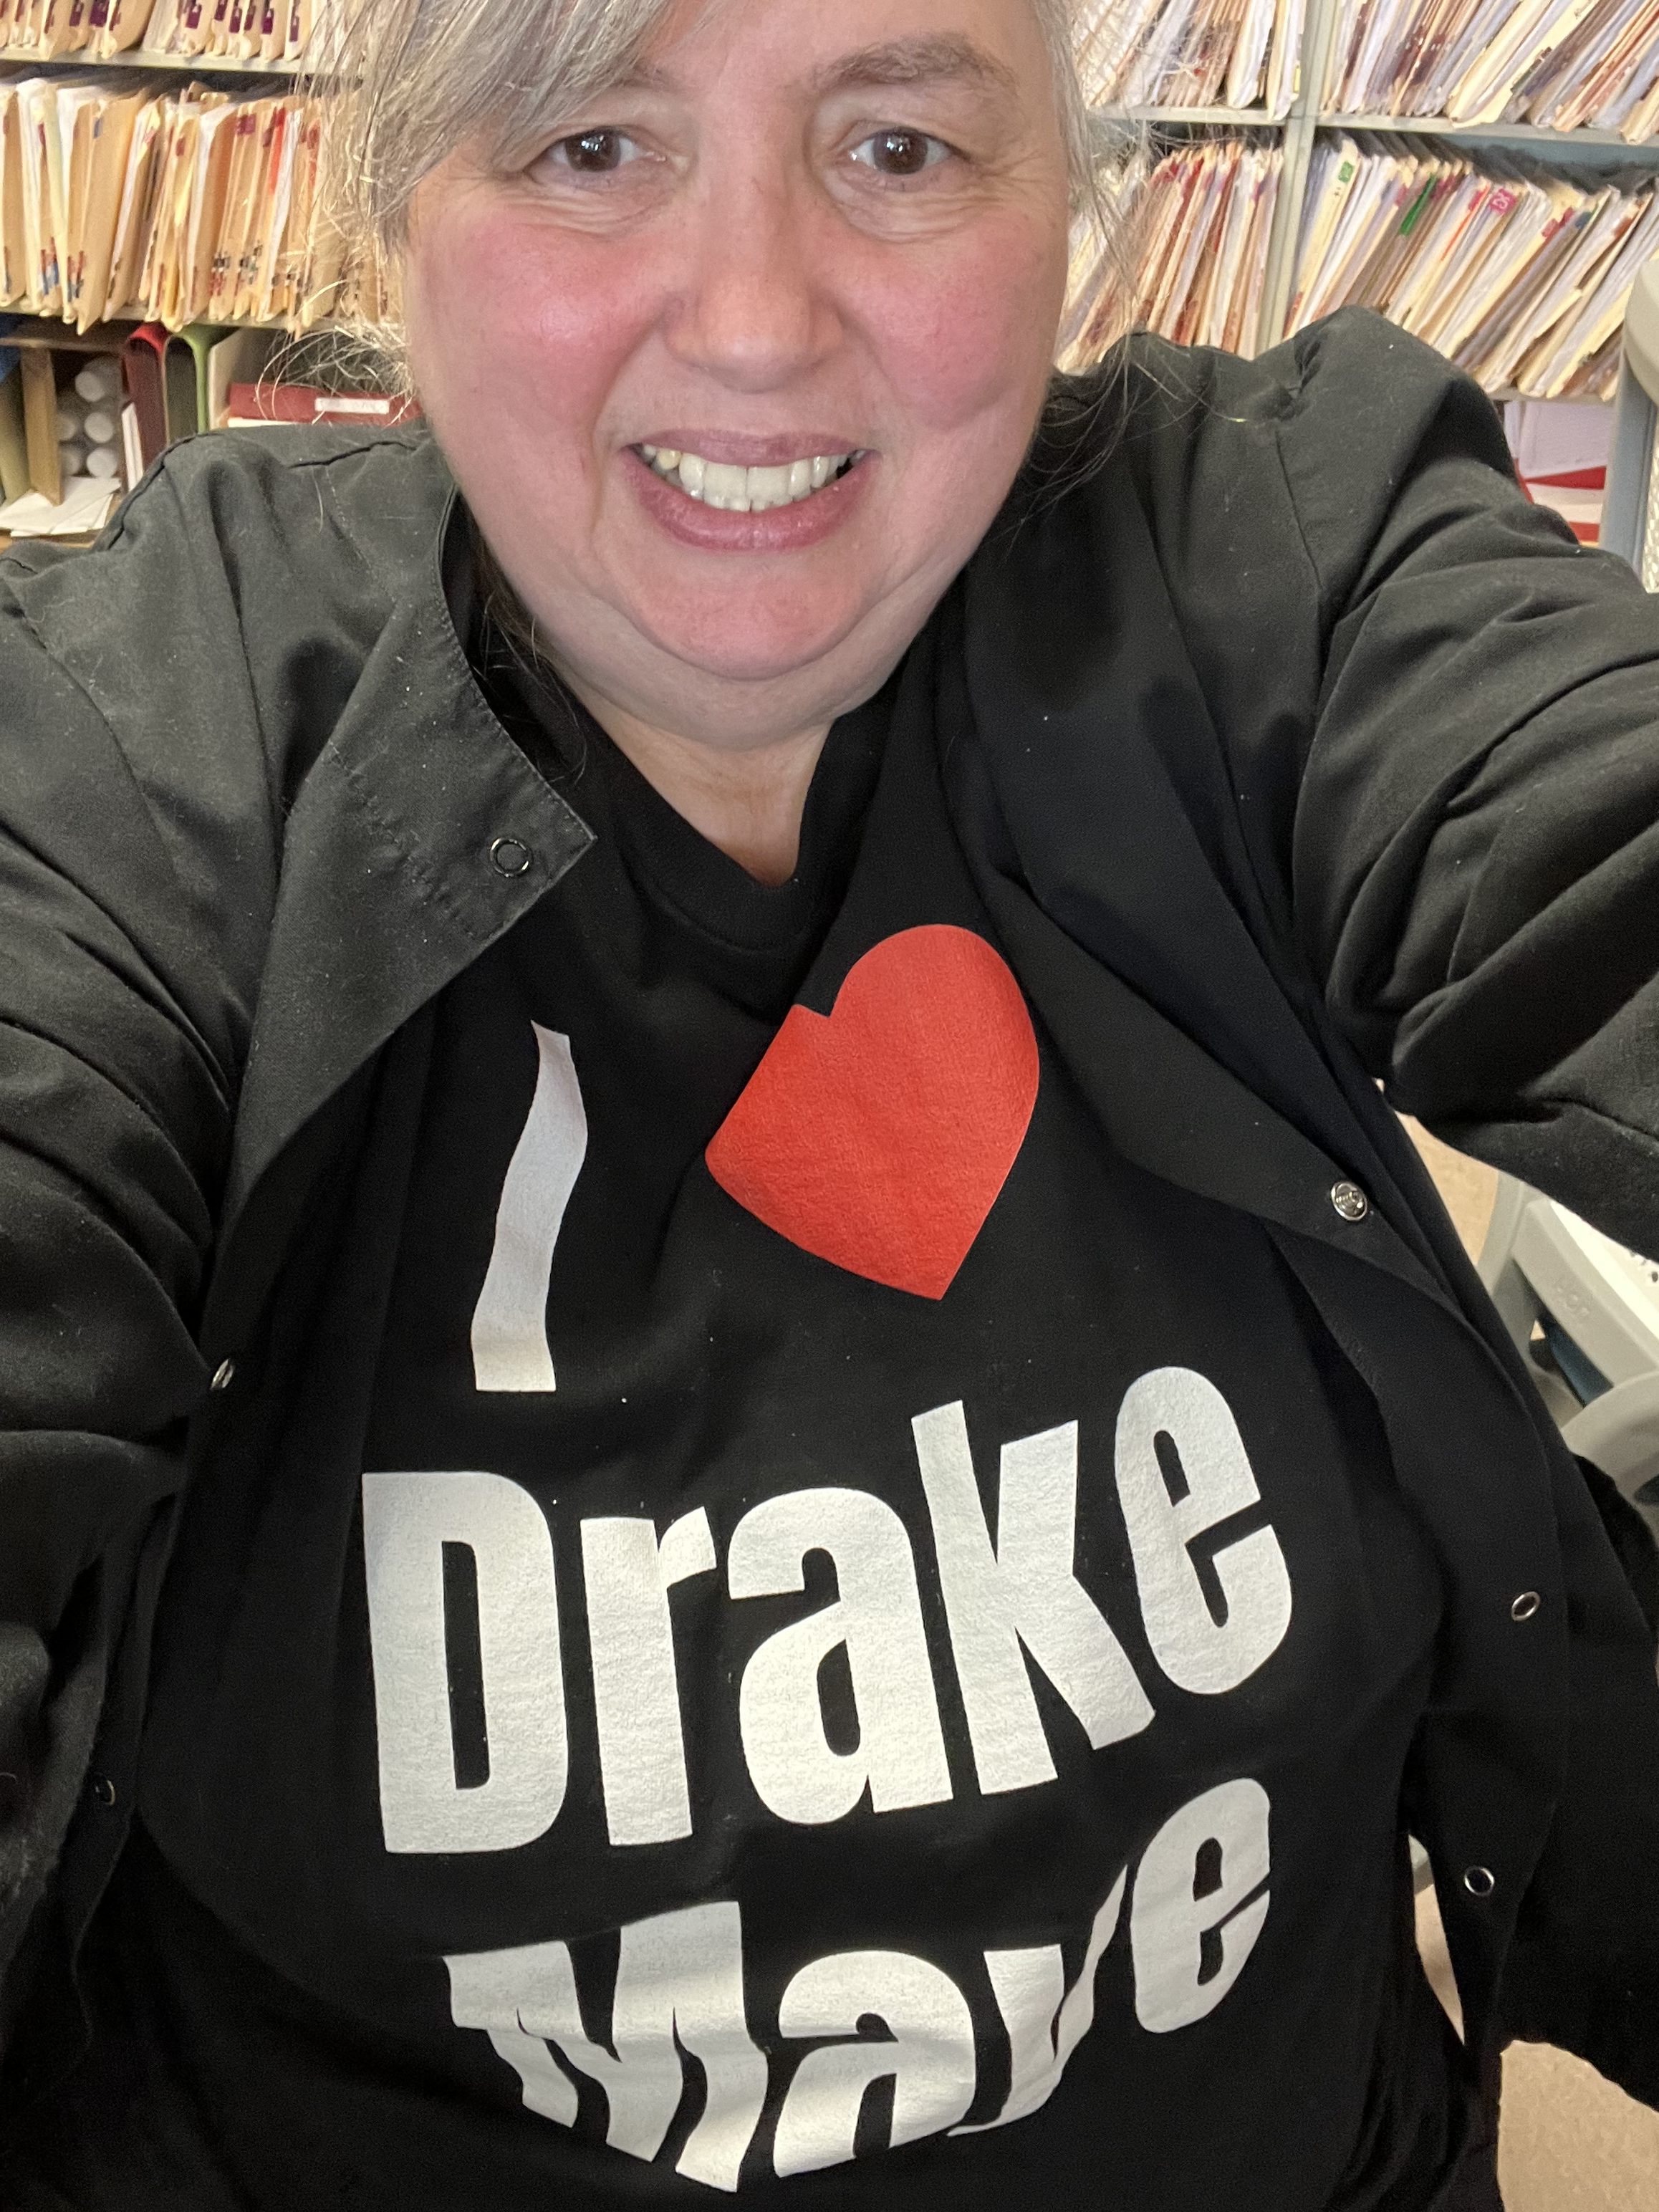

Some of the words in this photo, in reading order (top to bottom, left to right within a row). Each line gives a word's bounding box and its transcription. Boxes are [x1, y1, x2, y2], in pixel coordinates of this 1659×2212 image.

[470, 1019, 589, 1393] I
[361, 1365, 1293, 1854] Drake
[441, 1777, 1271, 2193] Maye
